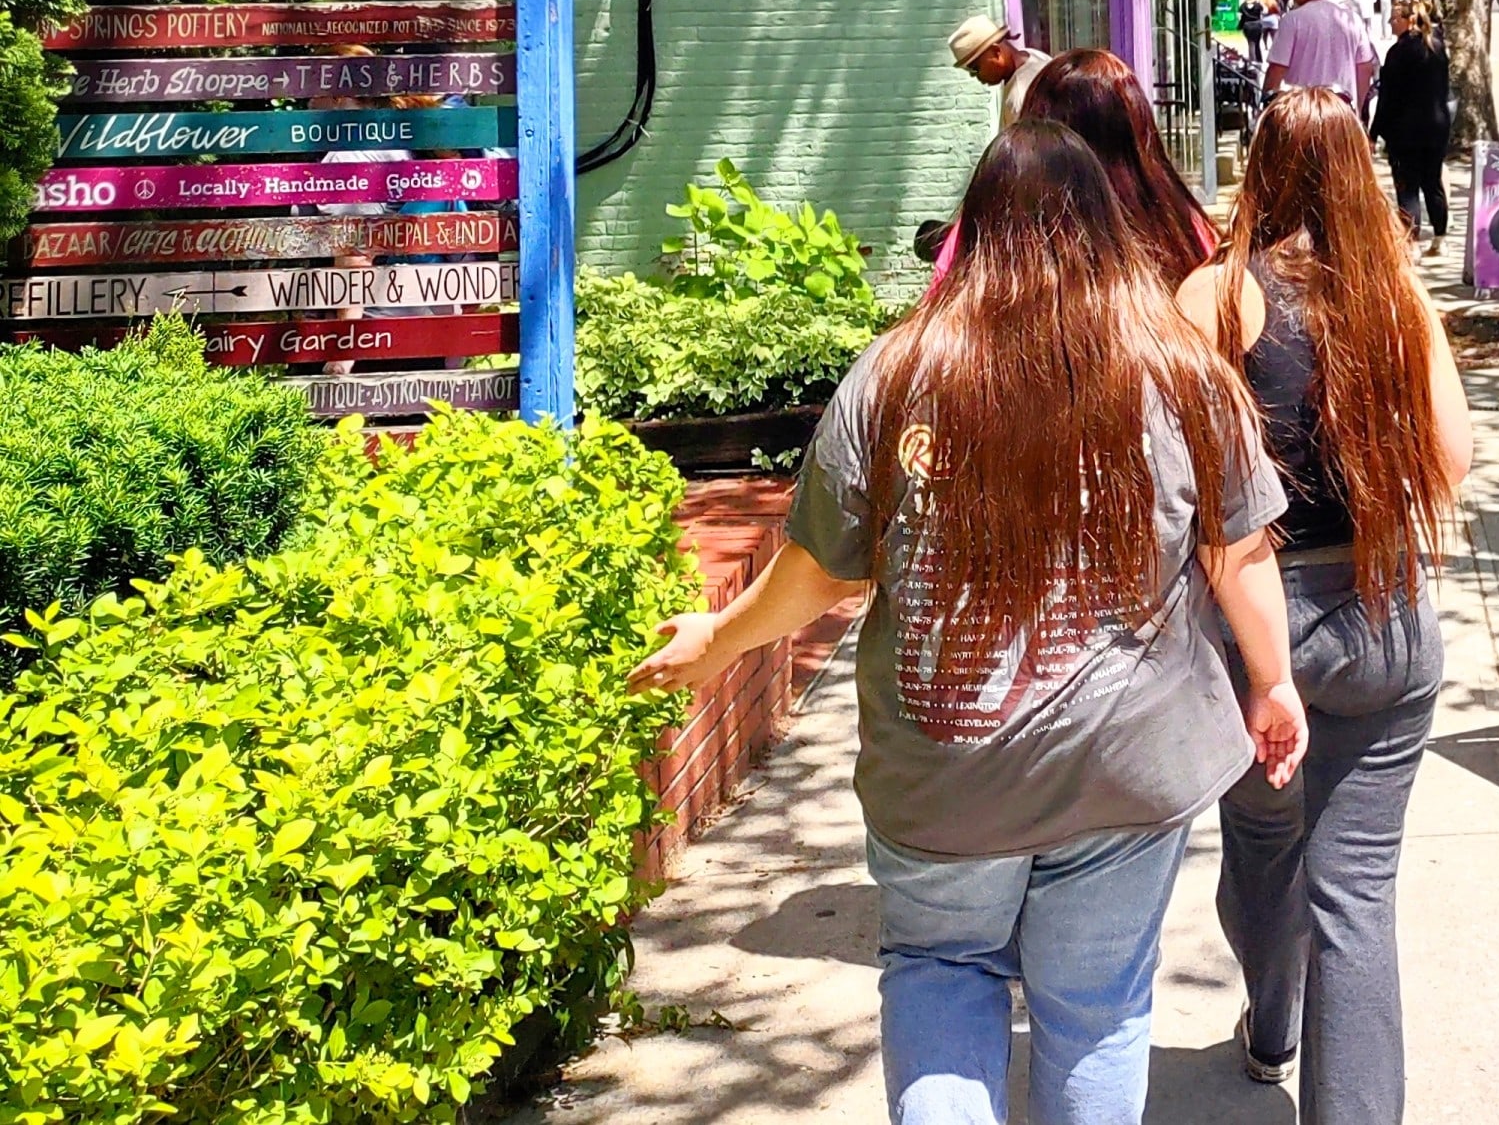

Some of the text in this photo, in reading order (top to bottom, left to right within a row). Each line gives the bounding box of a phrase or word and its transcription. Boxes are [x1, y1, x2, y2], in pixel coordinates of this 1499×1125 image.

[69, 14, 158, 40] SPRINGS
[168, 12, 250, 38] POTTERY
[94, 68, 161, 96] Herb
[163, 66, 268, 97] Shoppe
[296, 64, 372, 89] TEAS
[386, 61, 402, 91] &
[409, 61, 505, 88] HERBS
[291, 122, 414, 143] BOUTIQUE
[30, 173, 442, 206] asho Locally Handmade Goods
[0, 277, 148, 318] EFILLERY
[267, 269, 376, 307] WANDER
[387, 268, 403, 304] &
[206, 324, 392, 362] airy Garden
[304, 383, 366, 409] UTIQUE
[955, 719, 1001, 728] CLEVELAND
